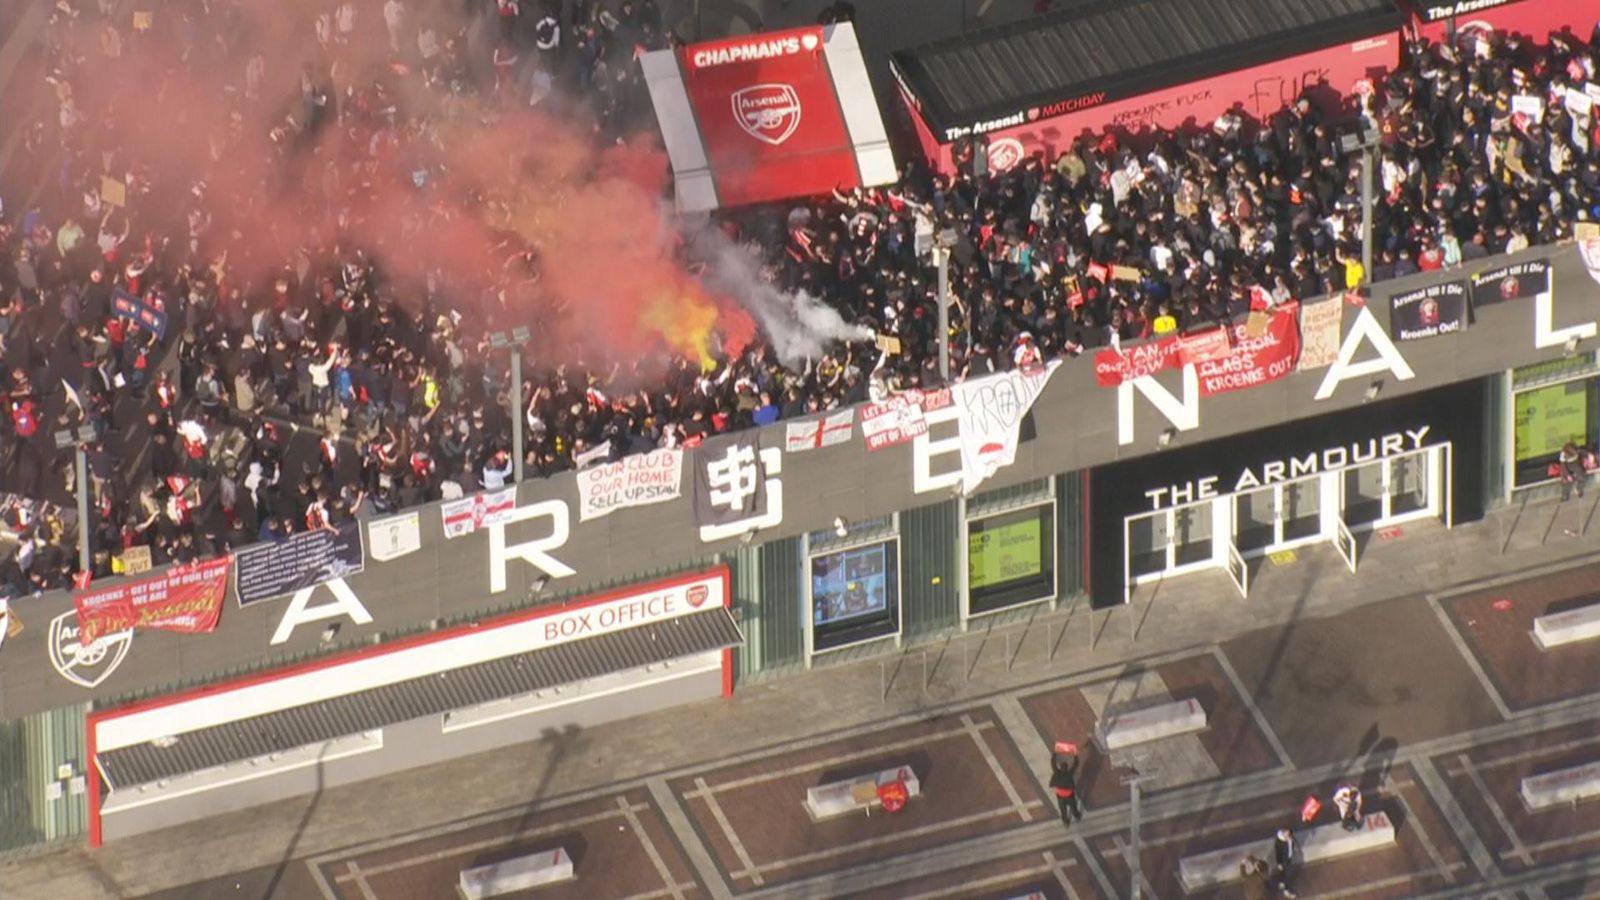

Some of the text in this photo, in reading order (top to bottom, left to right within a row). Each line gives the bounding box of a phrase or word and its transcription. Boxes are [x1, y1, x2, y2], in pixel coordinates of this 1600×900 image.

[1427, 0, 1507, 20] The Arsen
[694, 36, 800, 68] CHAPMAN'S
[741, 92, 789, 109] Arsenal
[945, 92, 1106, 140] The Arsenal MATCHDAY
[1474, 269, 1508, 287] Arsenal
[1529, 262, 1546, 273] Die
[1393, 288, 1426, 308] Arsenal
[1447, 284, 1464, 296] Die
[1400, 324, 1438, 340] Kroenke
[1200, 353, 1256, 377] CLASS
[1205, 367, 1266, 393] KROENKE
[1268, 355, 1293, 377] OUT
[869, 430, 888, 448] OUT
[589, 452, 675, 482] OUR CLUB
[1144, 425, 1430, 510] THE ARMOURY
[590, 469, 673, 496] OUR HOME
[588, 483, 678, 510] SELL UP STAN
[130, 584, 148, 596] GET
[149, 579, 168, 592] OUT
[169, 575, 181, 587] OF
[182, 570, 202, 584] OUR
[132, 590, 169, 606] WE ARE
[543, 593, 676, 641] BOX OFFICE
